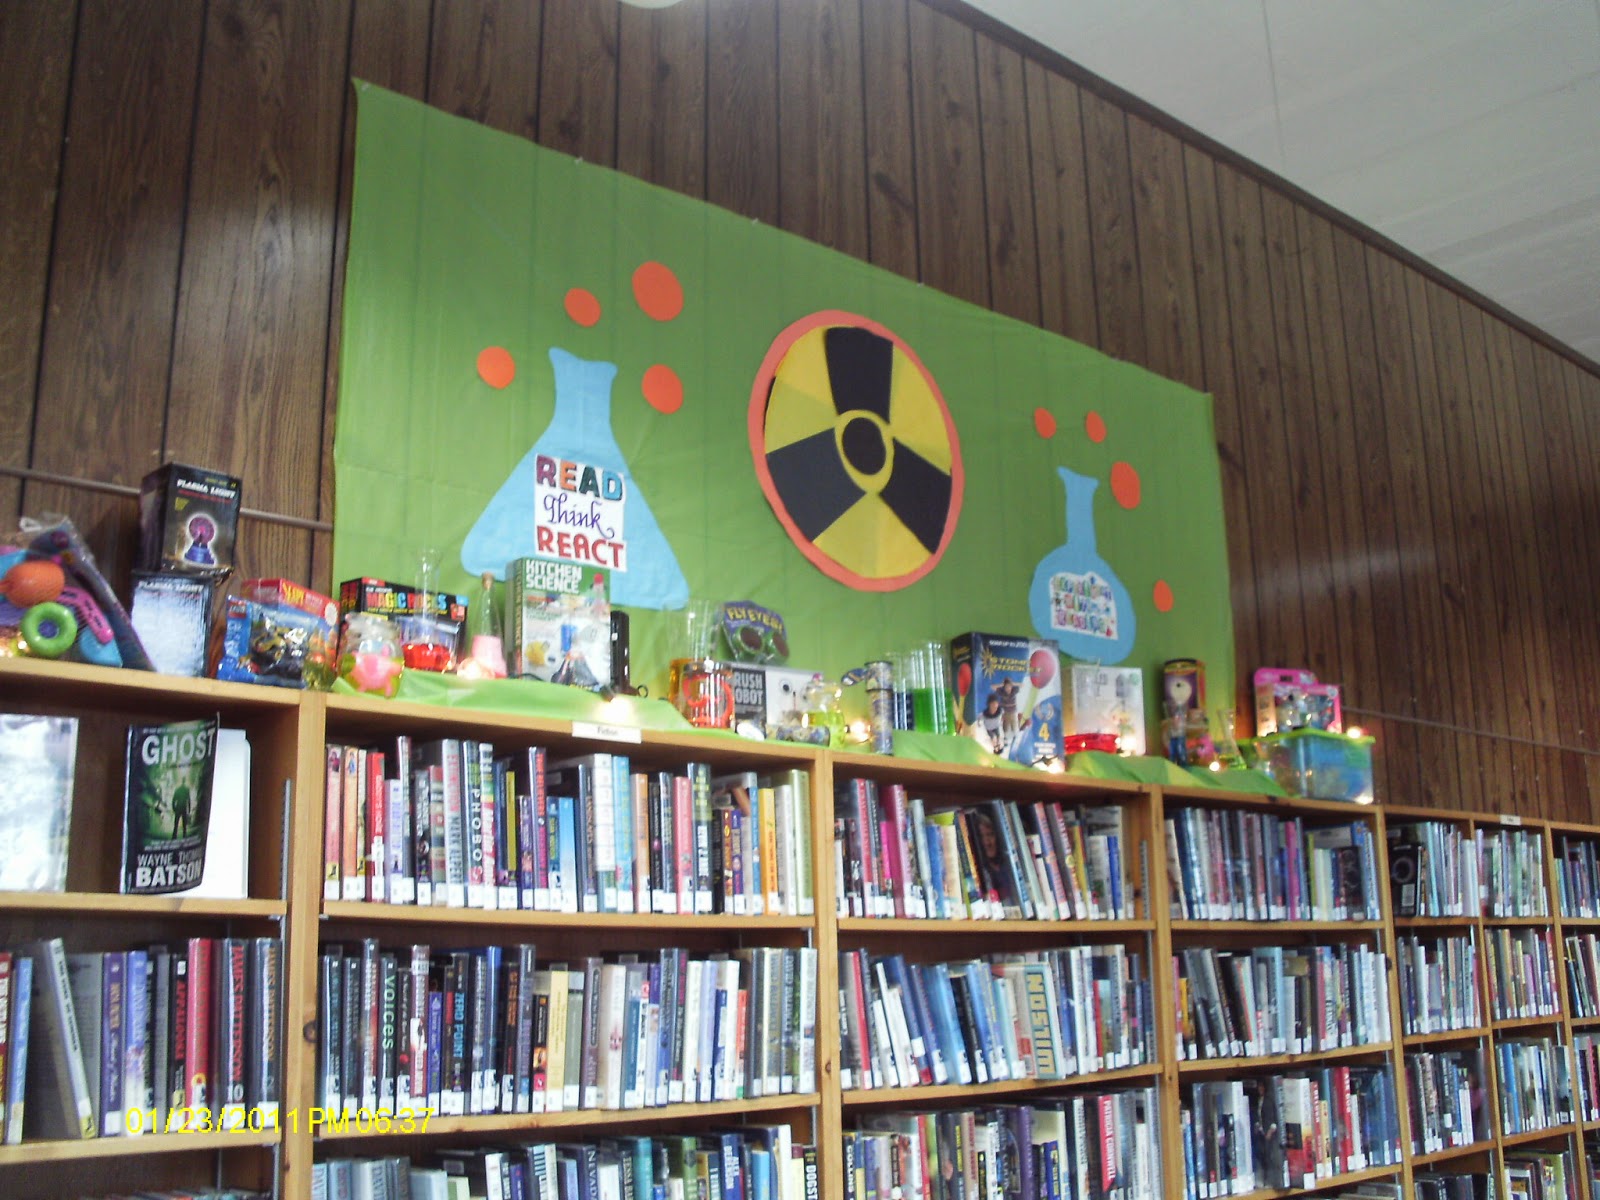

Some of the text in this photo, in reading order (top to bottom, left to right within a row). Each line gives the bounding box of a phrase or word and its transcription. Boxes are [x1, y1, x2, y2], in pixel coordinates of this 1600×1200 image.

[536, 455, 623, 501] READ
[543, 493, 615, 539] Think
[536, 525, 624, 568] REACT
[525, 559, 582, 581] KITCHEN
[526, 574, 580, 594] SCIENCE
[366, 591, 407, 610] MAGIC
[727, 607, 747, 621] FLY
[734, 671, 763, 690] RUSH
[734, 687, 763, 705] OBOT
[142, 727, 216, 767] GHOST
[1039, 722, 1050, 741] 4
[136, 860, 202, 888] BATSON
[138, 852, 174, 866] WAYNE
[232, 946, 244, 1081] JAMES PATTERSON
[383, 974, 396, 1050] voices
[453, 992, 465, 1059] ZERO POINT
[1026, 973, 1056, 1074] WILSON
[1104, 1100, 1116, 1180] PATRICIA CORNWELL
[806, 1165, 818, 1200] DOGST
[847, 1145, 855, 1193] COLLINS
